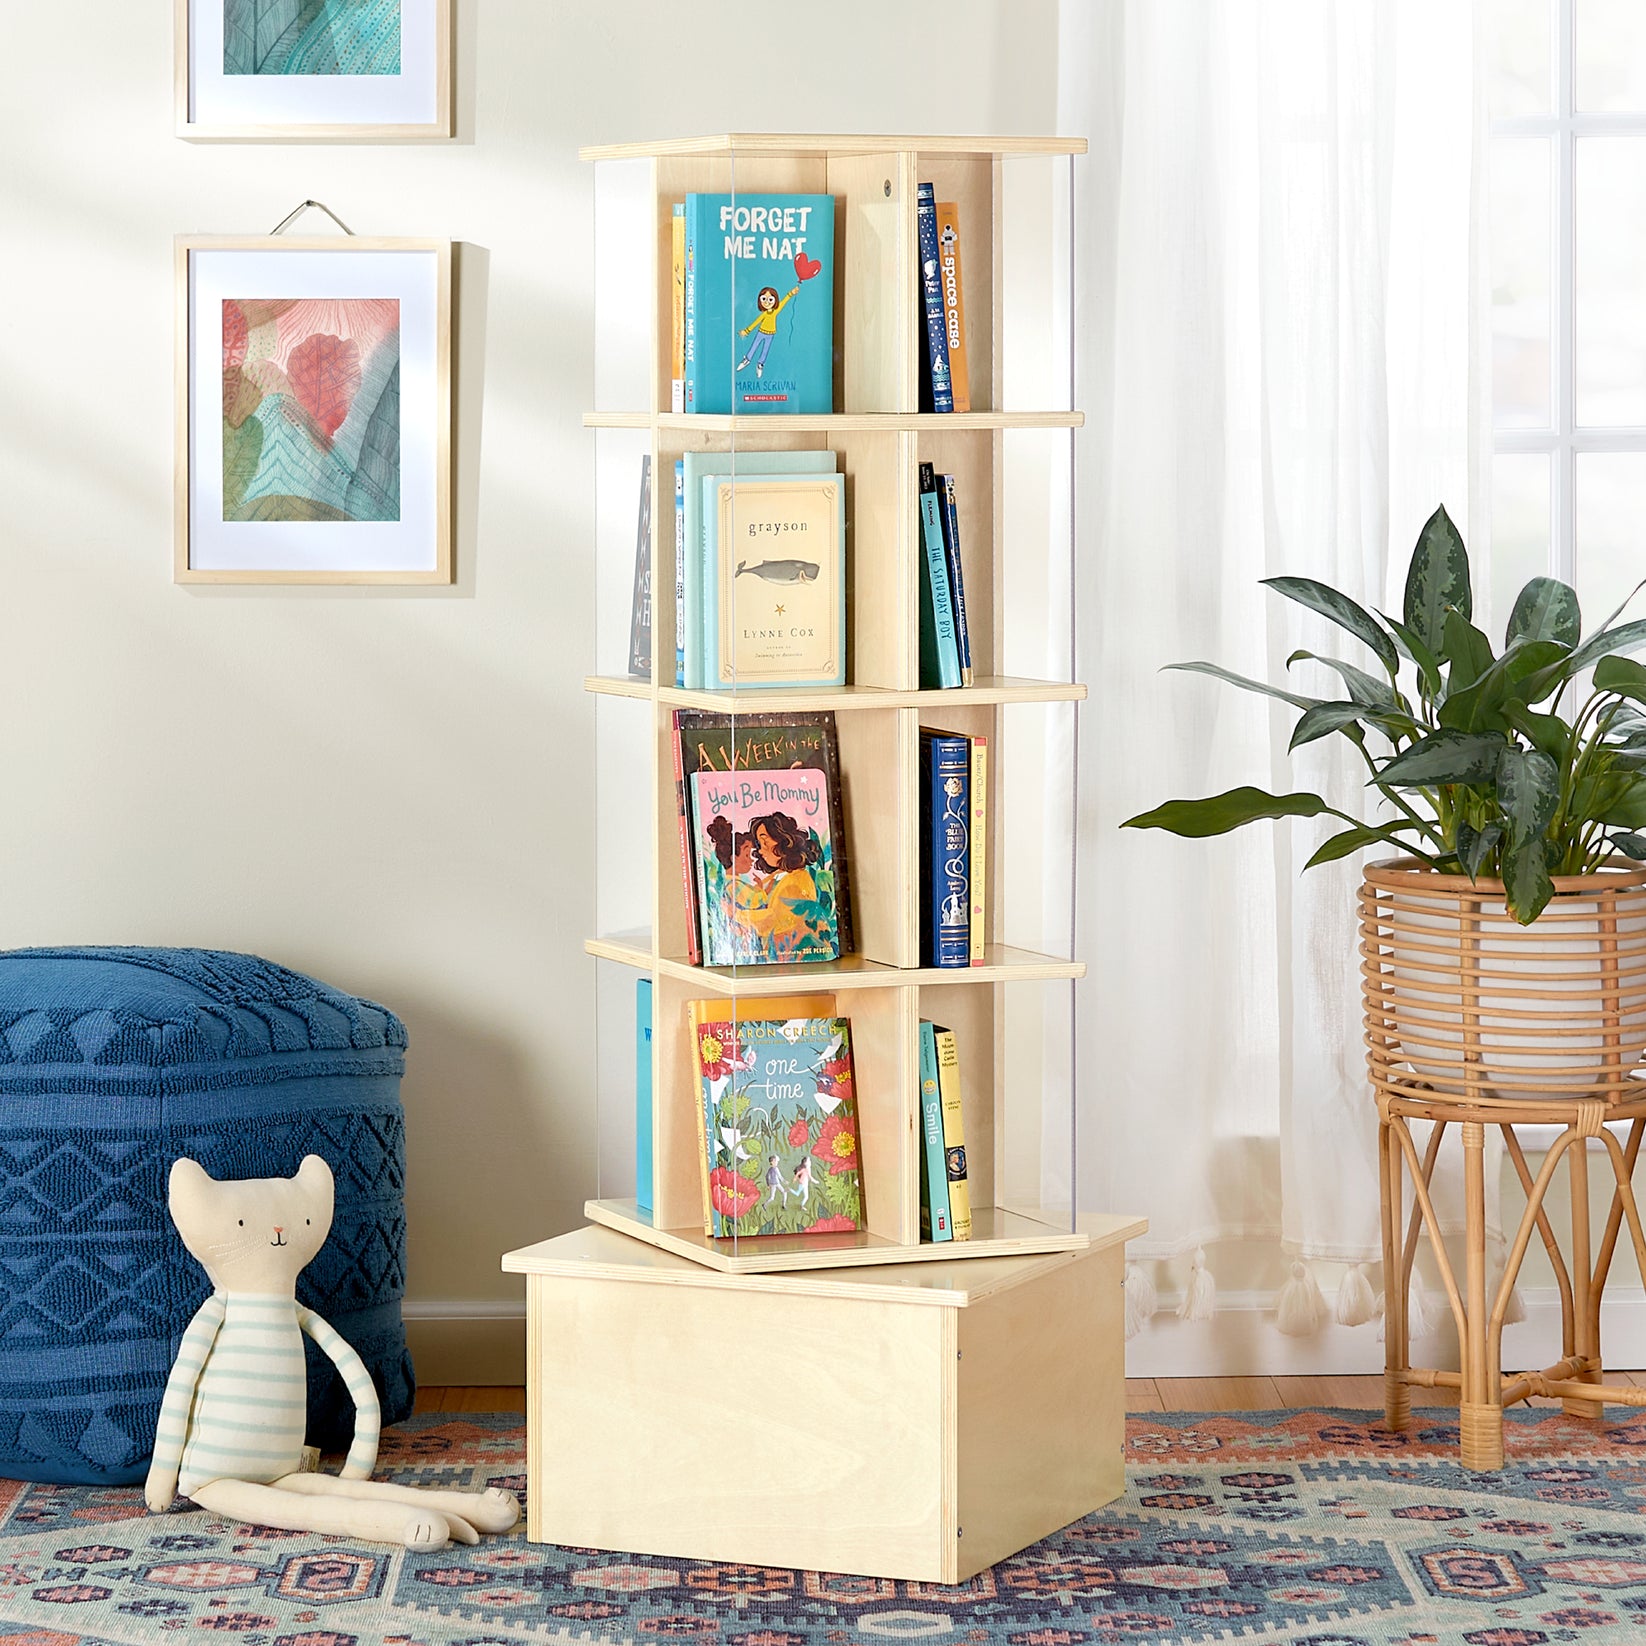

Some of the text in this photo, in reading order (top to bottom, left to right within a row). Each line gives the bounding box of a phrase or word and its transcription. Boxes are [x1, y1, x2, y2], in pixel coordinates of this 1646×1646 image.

[720, 205, 813, 233] FORGET
[724, 235, 807, 260] ME NAT
[942, 257, 960, 349] space case
[687, 275, 695, 363] FORGET ME NAT
[735, 380, 797, 391] MARIA SCRIVAN
[748, 522, 808, 537] grayson
[931, 547, 952, 640] THE SATURDAY BOY
[743, 627, 814, 639] LYNNE COX
[697, 742, 718, 772] A
[719, 736, 783, 771] WEEK
[785, 739, 797, 751] IN
[707, 787, 739, 815] You
[740, 782, 762, 809] Be
[763, 780, 820, 816] Mommy
[716, 1025, 837, 1040] SHARON CREECH
[765, 1058, 809, 1076] one
[756, 1078, 804, 1100] time
[926, 1102, 940, 1145] Smile
